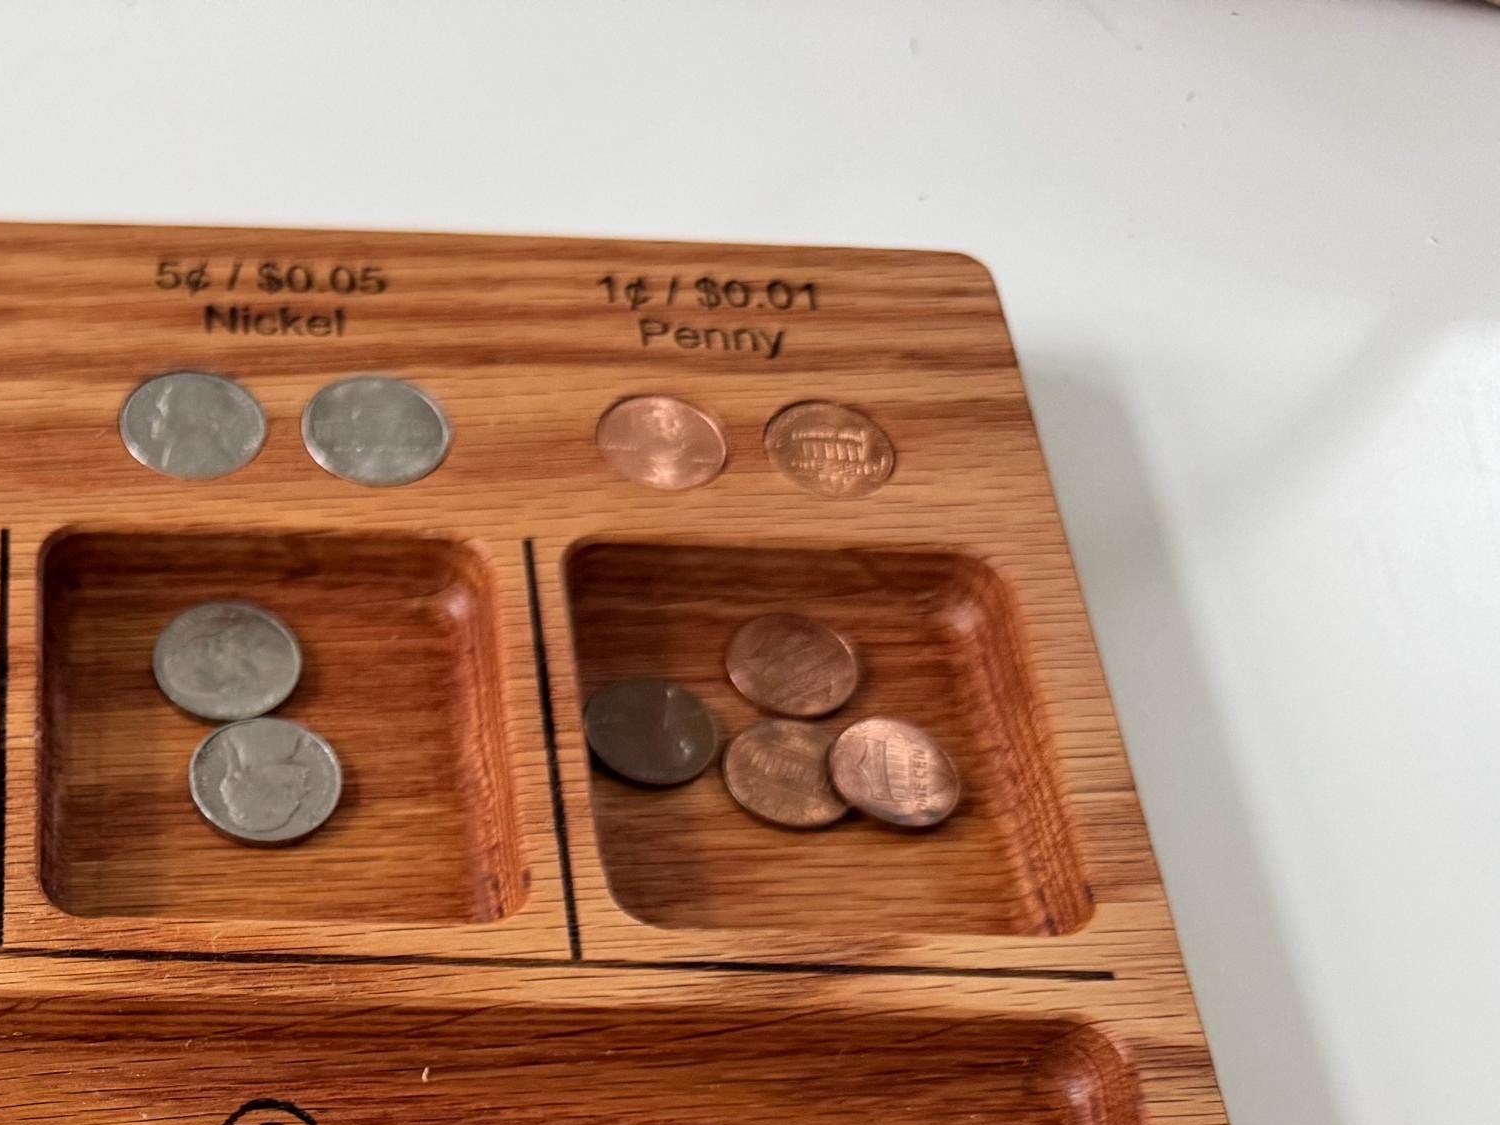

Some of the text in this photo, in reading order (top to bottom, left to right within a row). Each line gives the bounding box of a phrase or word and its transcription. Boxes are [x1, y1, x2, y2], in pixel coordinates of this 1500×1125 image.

[155, 260, 388, 296] 5¢ / $0.05
[597, 275, 819, 311] 1¢ / $0.01
[202, 303, 347, 337] Nickel
[638, 317, 786, 361] Penny
